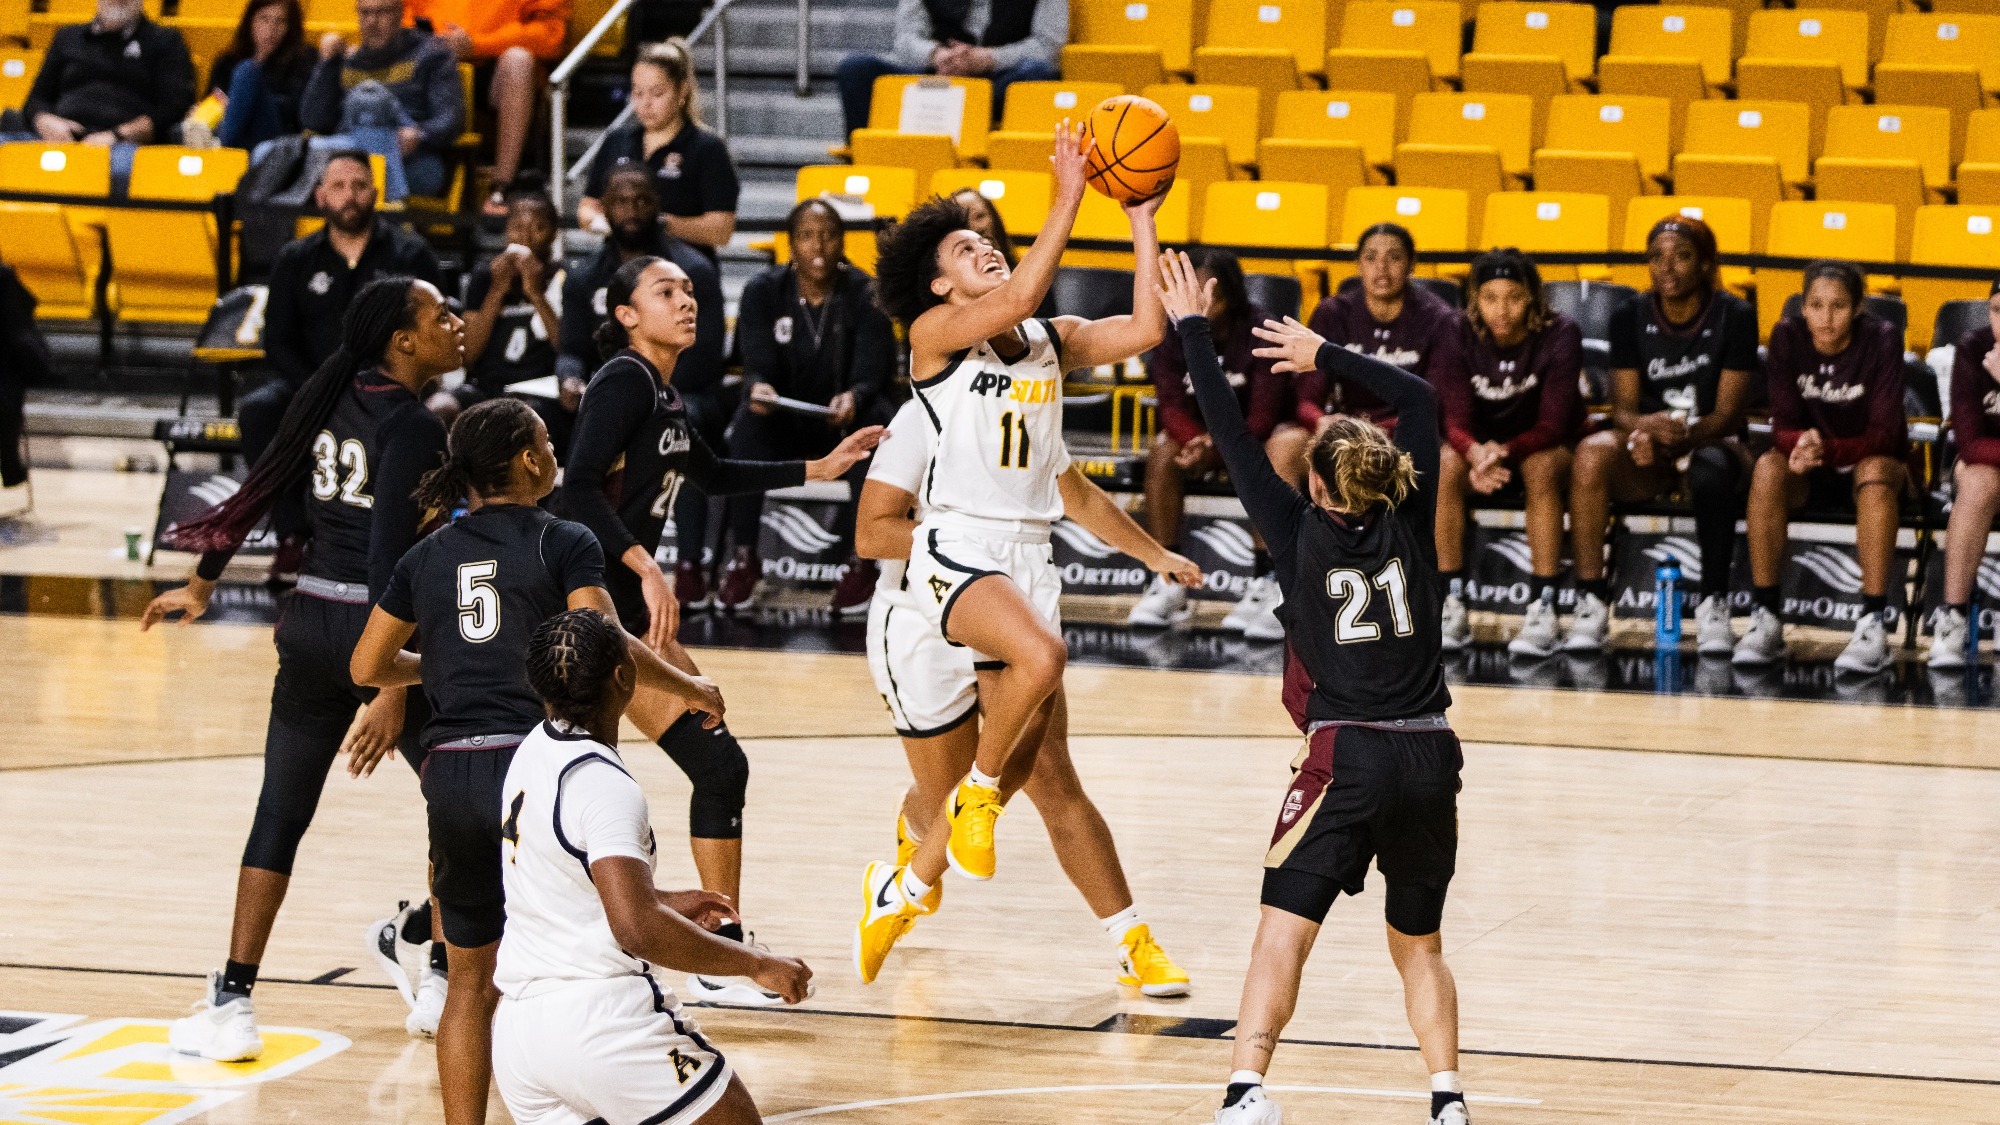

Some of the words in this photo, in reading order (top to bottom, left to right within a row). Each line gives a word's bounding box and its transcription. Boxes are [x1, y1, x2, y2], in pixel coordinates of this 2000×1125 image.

[312, 429, 374, 509] 32
[999, 409, 1031, 469] 11
[457, 559, 501, 644] 5
[1326, 557, 1414, 645] 21
